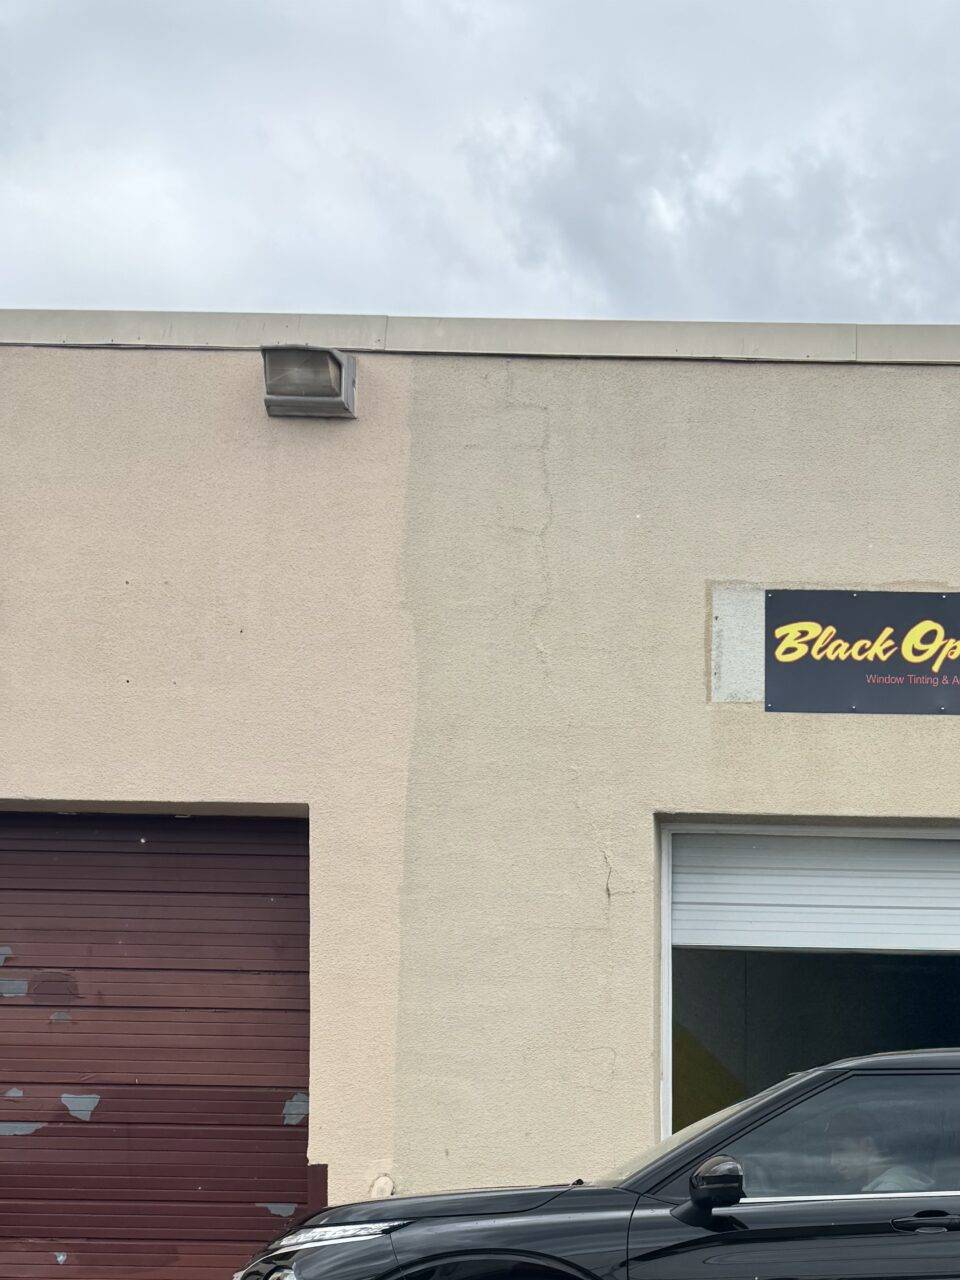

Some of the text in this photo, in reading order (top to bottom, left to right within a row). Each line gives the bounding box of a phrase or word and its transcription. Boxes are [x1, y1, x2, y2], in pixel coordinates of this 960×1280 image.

[774, 621, 898, 664] Black
[866, 674, 904, 685] Window
[907, 675, 939, 687] Tinting
[942, 675, 949, 685] &
